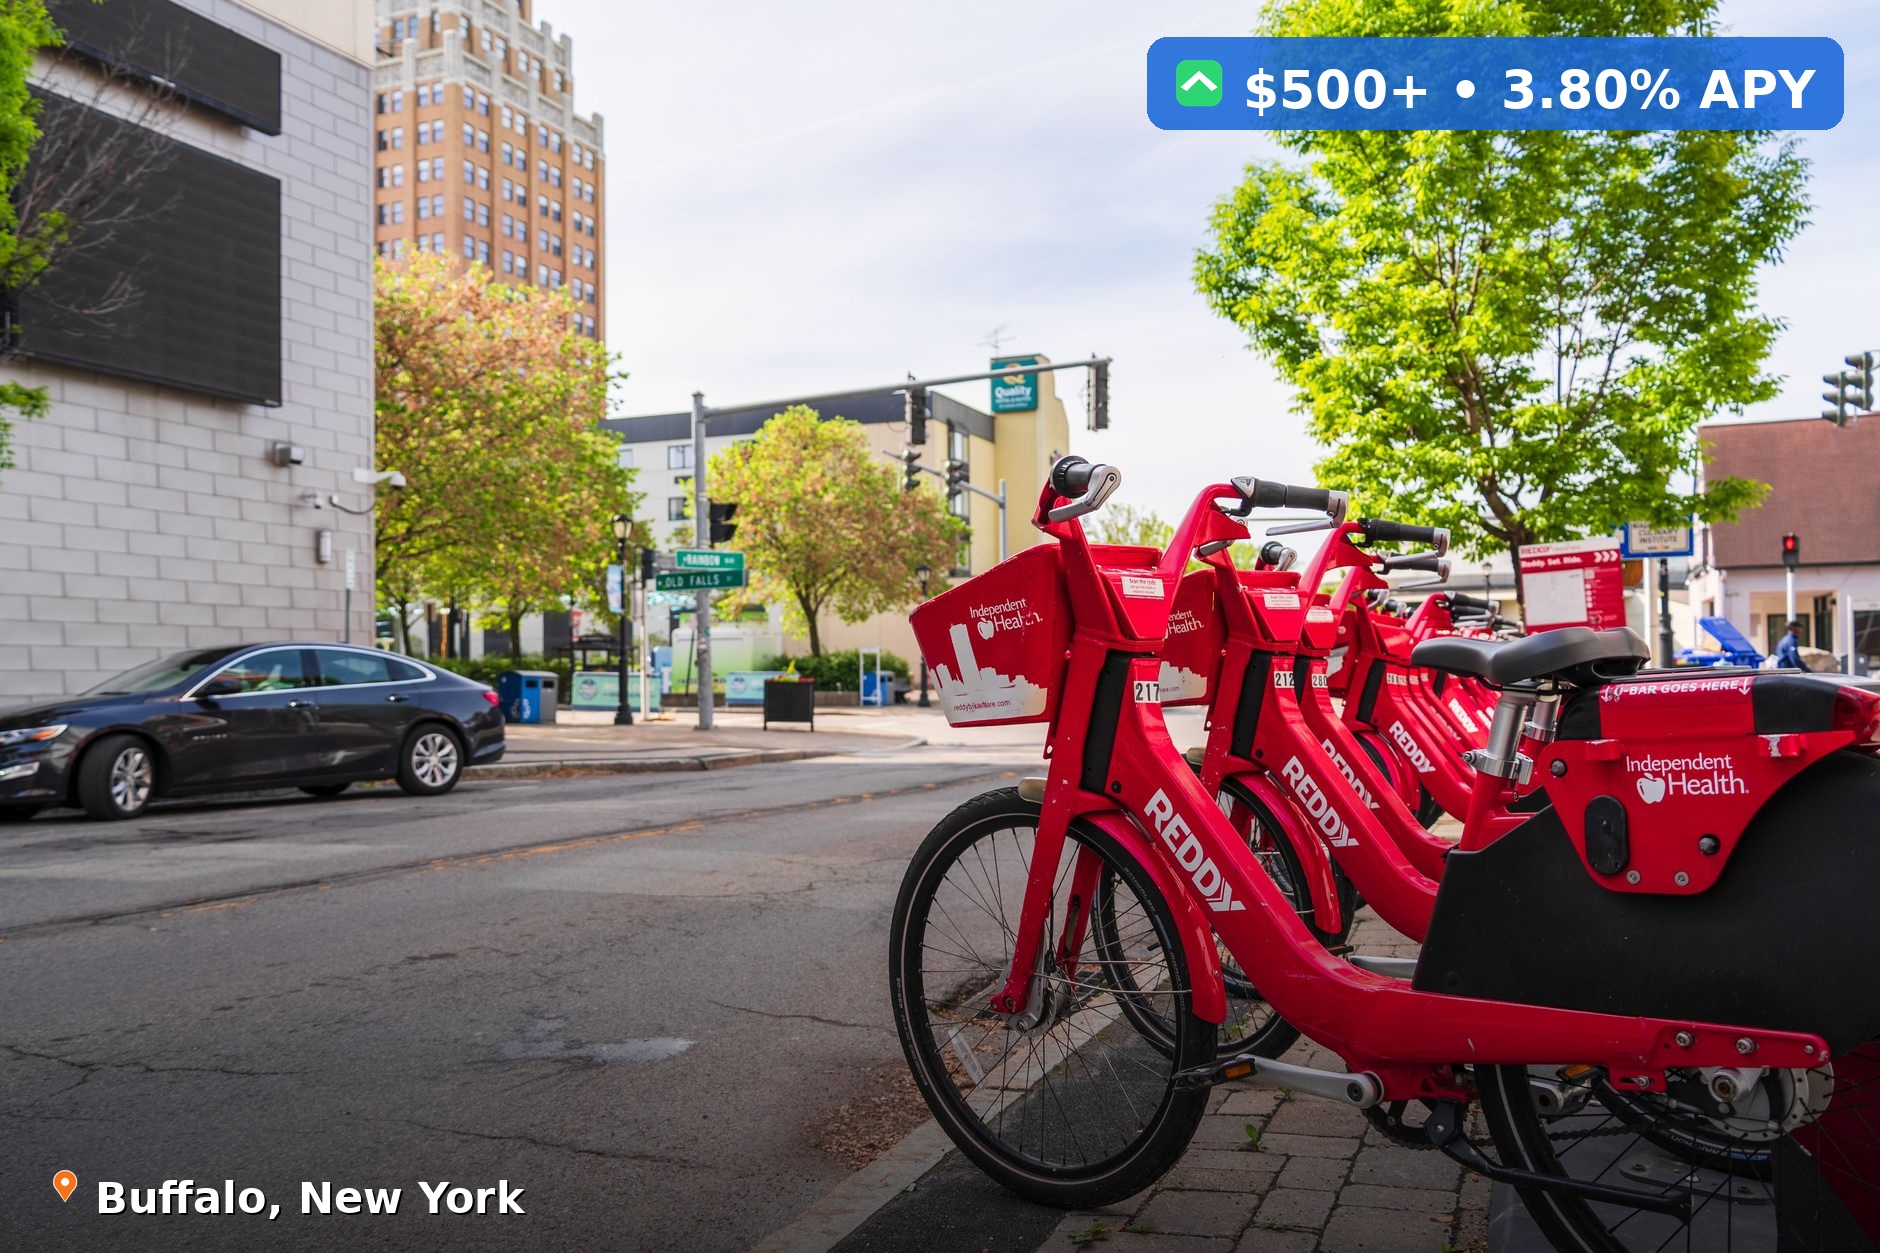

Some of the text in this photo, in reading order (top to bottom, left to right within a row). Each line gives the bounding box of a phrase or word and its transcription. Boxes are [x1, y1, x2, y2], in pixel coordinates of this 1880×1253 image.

[686, 554, 721, 566] RAINBOW
[665, 576, 684, 588] OLD
[689, 574, 720, 586] FALLS
[969, 597, 1027, 619] Independent
[1168, 609, 1193, 622] endent
[1275, 672, 1294, 688] 212
[1312, 675, 1328, 688] 280
[1660, 681, 1698, 694] GOES
[1700, 677, 1739, 692] HERE
[1135, 681, 1160, 703] 217
[1388, 720, 1436, 774] REDDY
[1625, 752, 1733, 778] Independent
[1281, 755, 1360, 849] REDDY
[1143, 787, 1246, 912] REDDY
